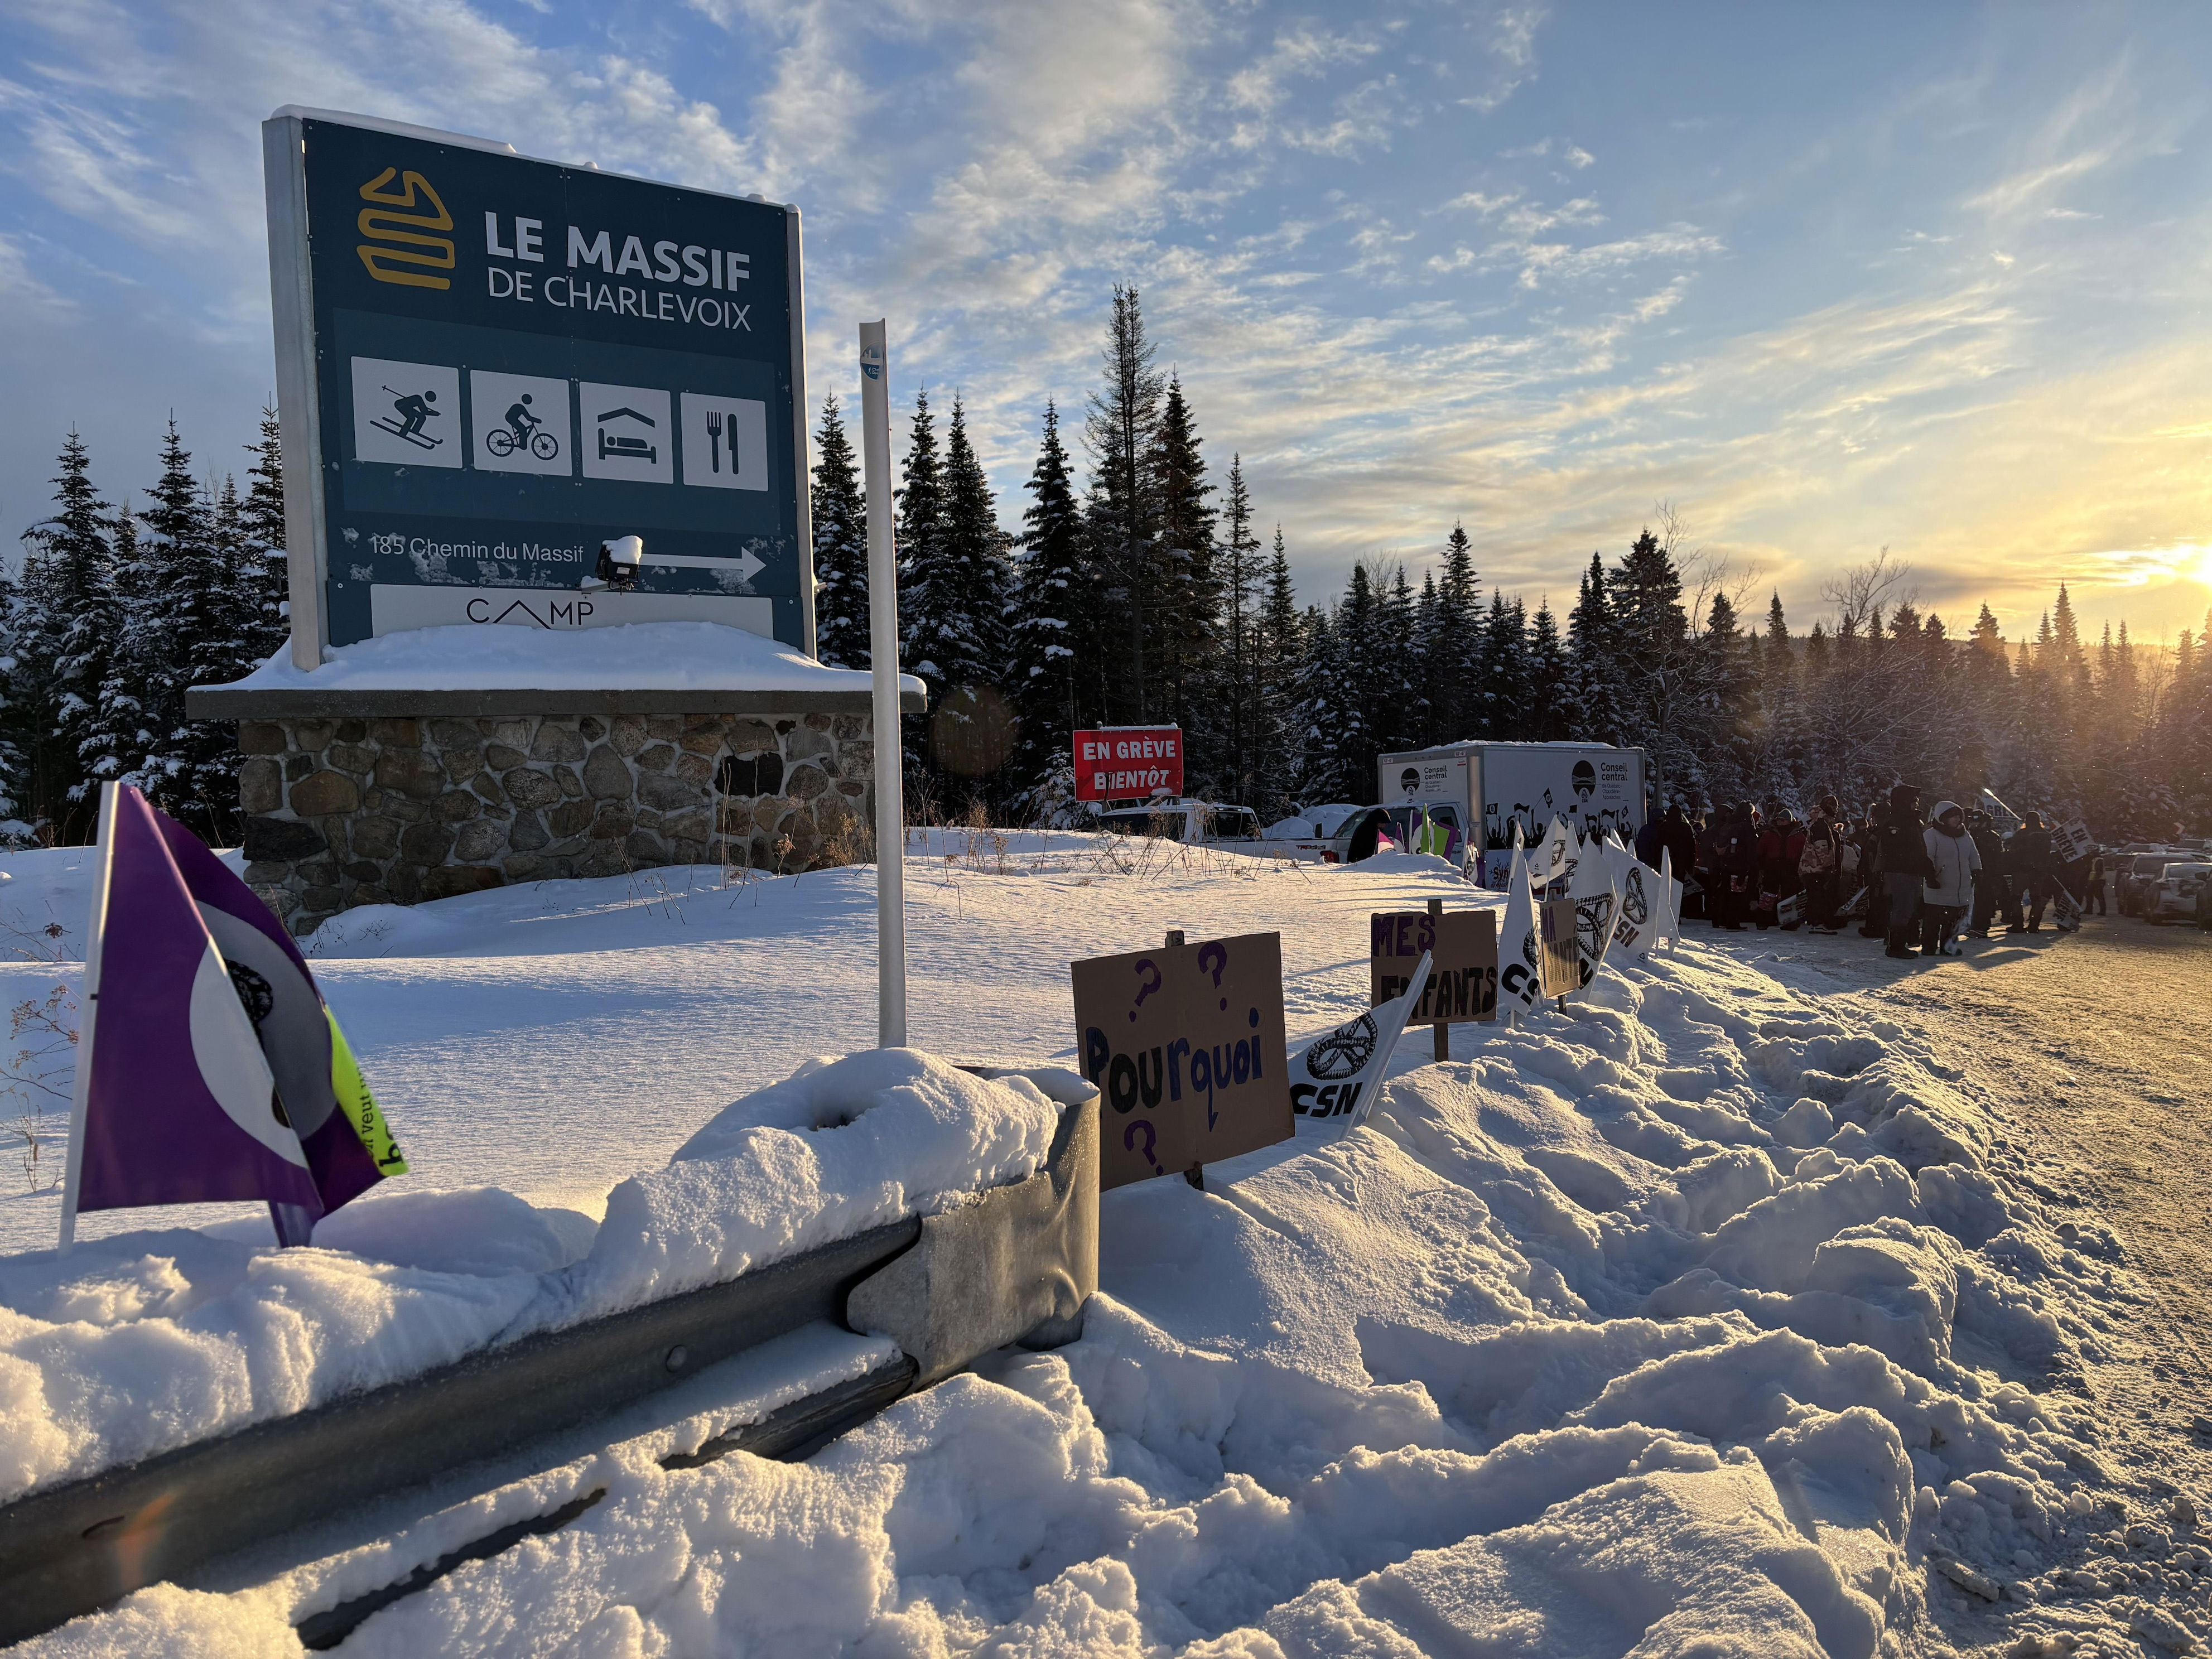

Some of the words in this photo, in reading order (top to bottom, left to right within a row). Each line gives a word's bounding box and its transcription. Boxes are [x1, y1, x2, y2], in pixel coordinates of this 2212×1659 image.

[485, 211, 544, 263] LE
[567, 224, 750, 292] MASSIF
[488, 267, 533, 302] DE
[544, 276, 753, 332] CHARLEVOIX
[371, 536, 404, 554] 185
[409, 537, 489, 558] Chemin
[493, 542, 517, 560] du
[522, 542, 584, 563] Massif
[466, 598, 594, 629] CAMP
[1083, 741, 1111, 760] EN
[1116, 736, 1176, 759] GRÈVE
[1094, 765, 1169, 790] BIENTÔT
[1424, 765, 1448, 774] Conseil
[1424, 771, 1447, 780] central
[1601, 762, 1628, 772] Conseil
[1601, 771, 1628, 781] central
[1372, 914, 1436, 957] MES
[1612, 915, 1640, 948] SN
[1085, 1007, 1262, 1132] Pourquoi
[359, 1094, 374, 1134] veut
[1289, 1082, 1363, 1118] CSN
